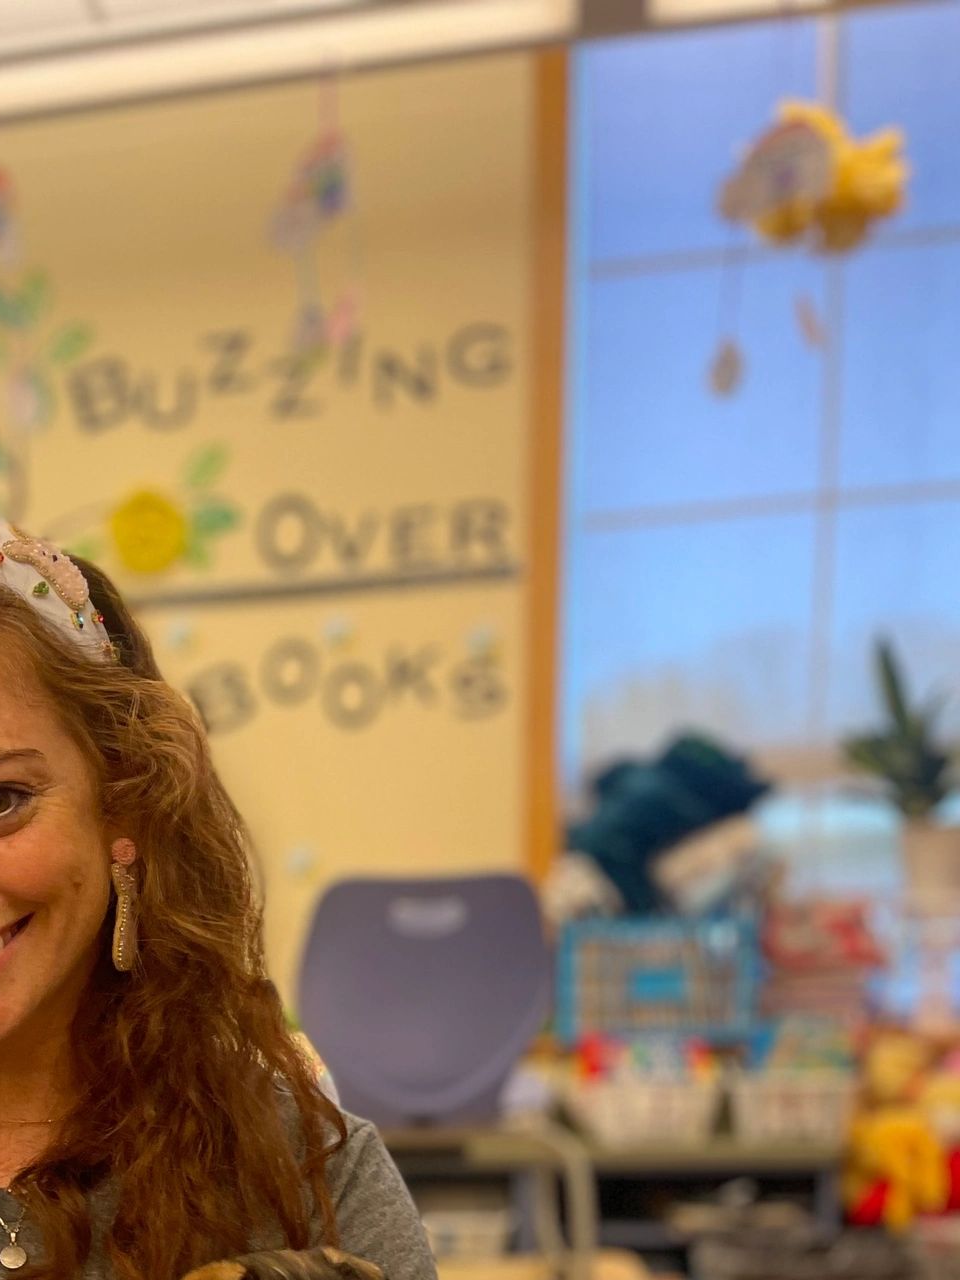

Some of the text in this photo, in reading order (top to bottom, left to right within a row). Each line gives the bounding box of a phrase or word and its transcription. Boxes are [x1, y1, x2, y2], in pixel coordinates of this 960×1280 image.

[70, 322, 512, 435] BUZZING
[256, 493, 509, 574] OVER
[190, 637, 508, 735] BOOKS
